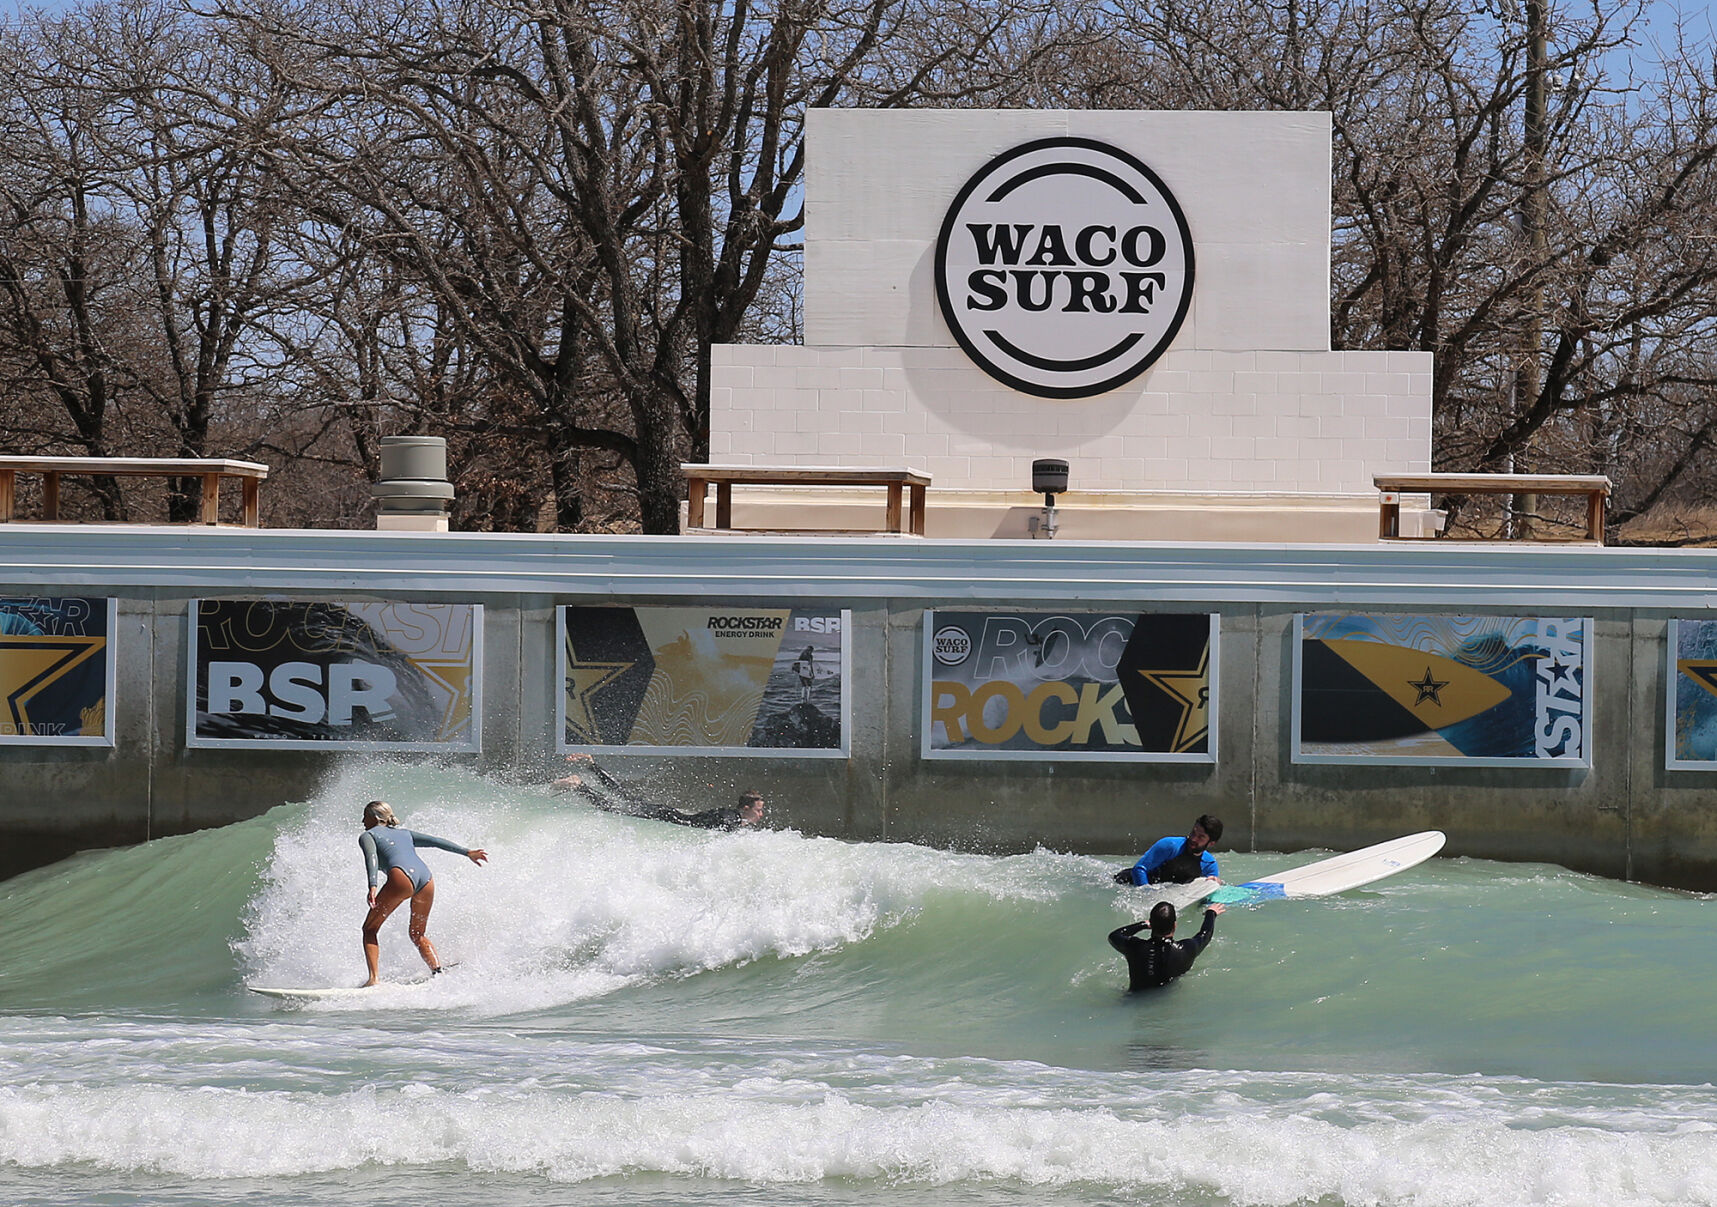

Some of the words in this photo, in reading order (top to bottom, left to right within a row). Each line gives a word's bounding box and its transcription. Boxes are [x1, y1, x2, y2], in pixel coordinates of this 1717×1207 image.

[965, 223, 1167, 267] WACO
[966, 269, 1166, 314] SURF
[707, 616, 783, 630] ROCKSTAR
[936, 638, 968, 646] WACO
[207, 660, 397, 726] BSR
